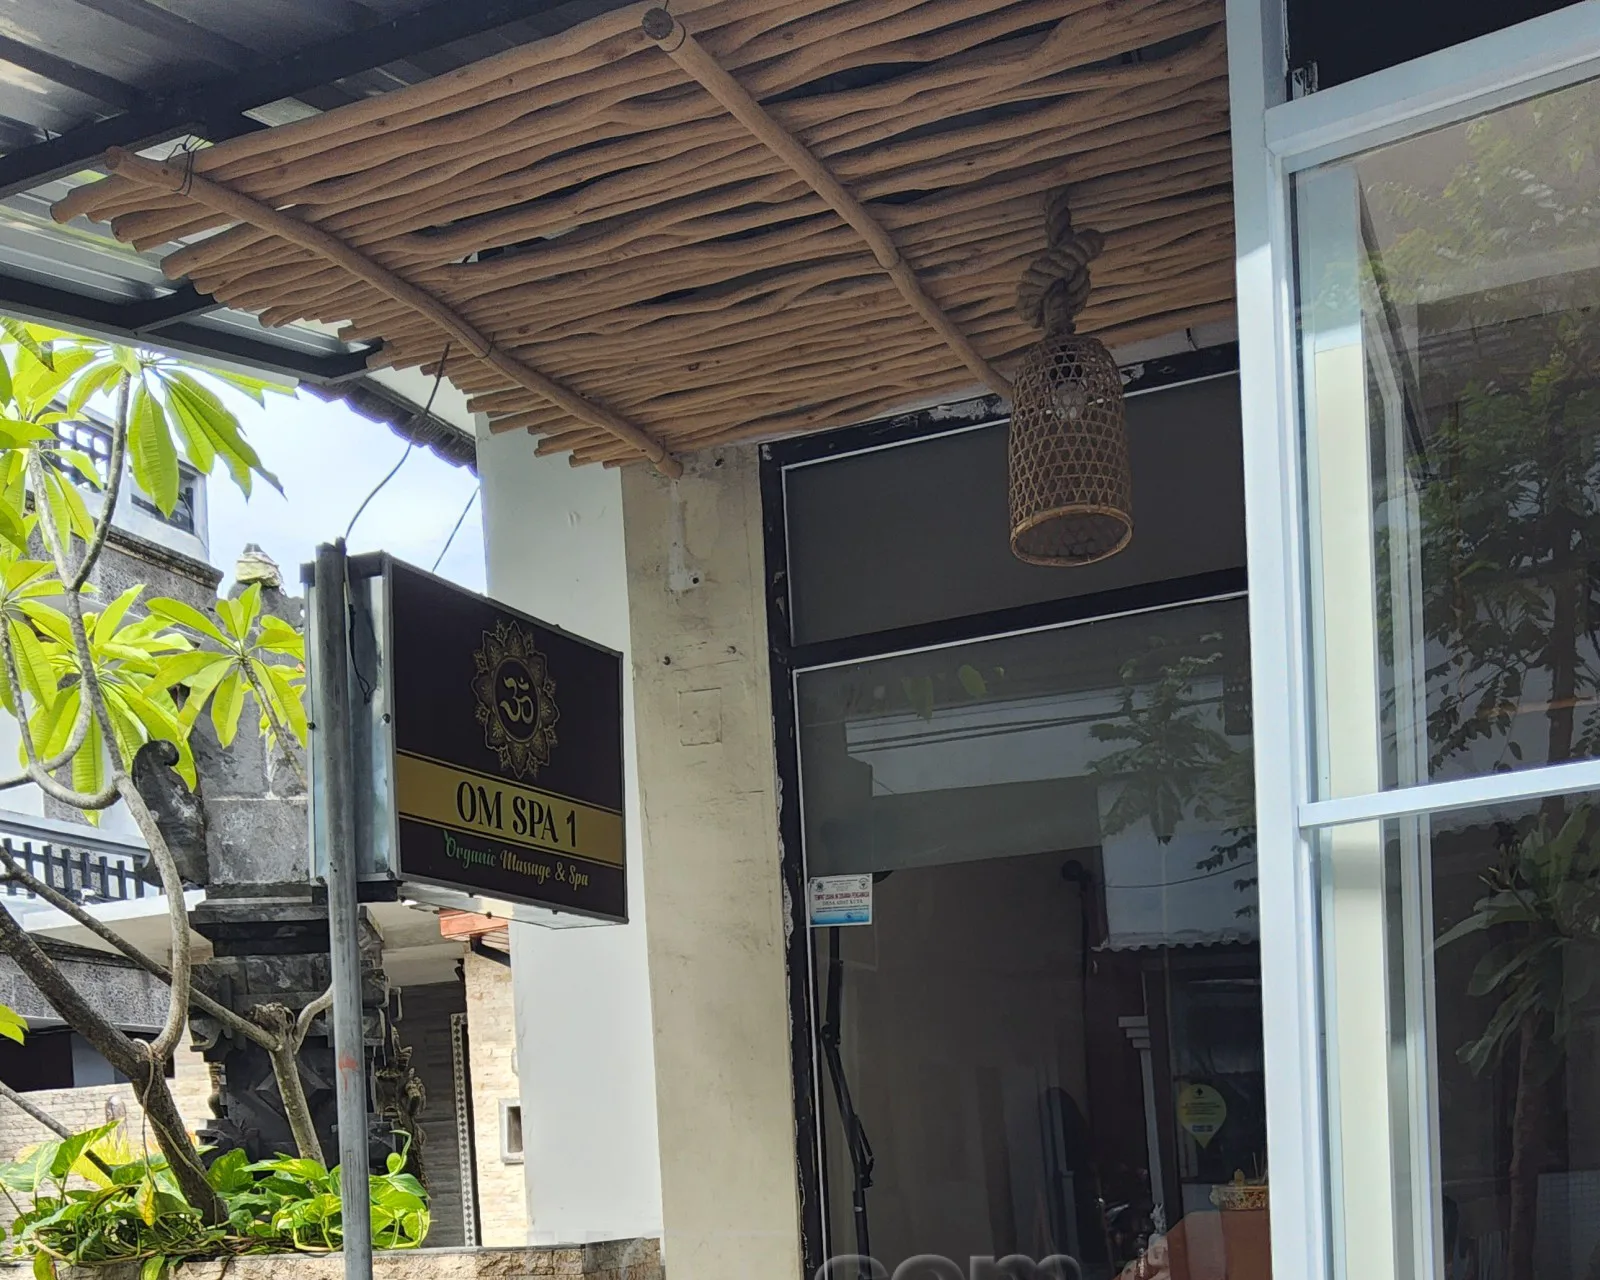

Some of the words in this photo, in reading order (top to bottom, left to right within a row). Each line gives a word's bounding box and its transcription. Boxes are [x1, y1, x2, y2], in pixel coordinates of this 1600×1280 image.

[456, 781, 503, 830] OM
[512, 795, 559, 844] SPA
[566, 810, 577, 848] 1
[444, 831, 497, 869] Organic
[500, 850, 551, 885] Massage
[554, 861, 566, 882] &
[568, 864, 589, 891] Spa
